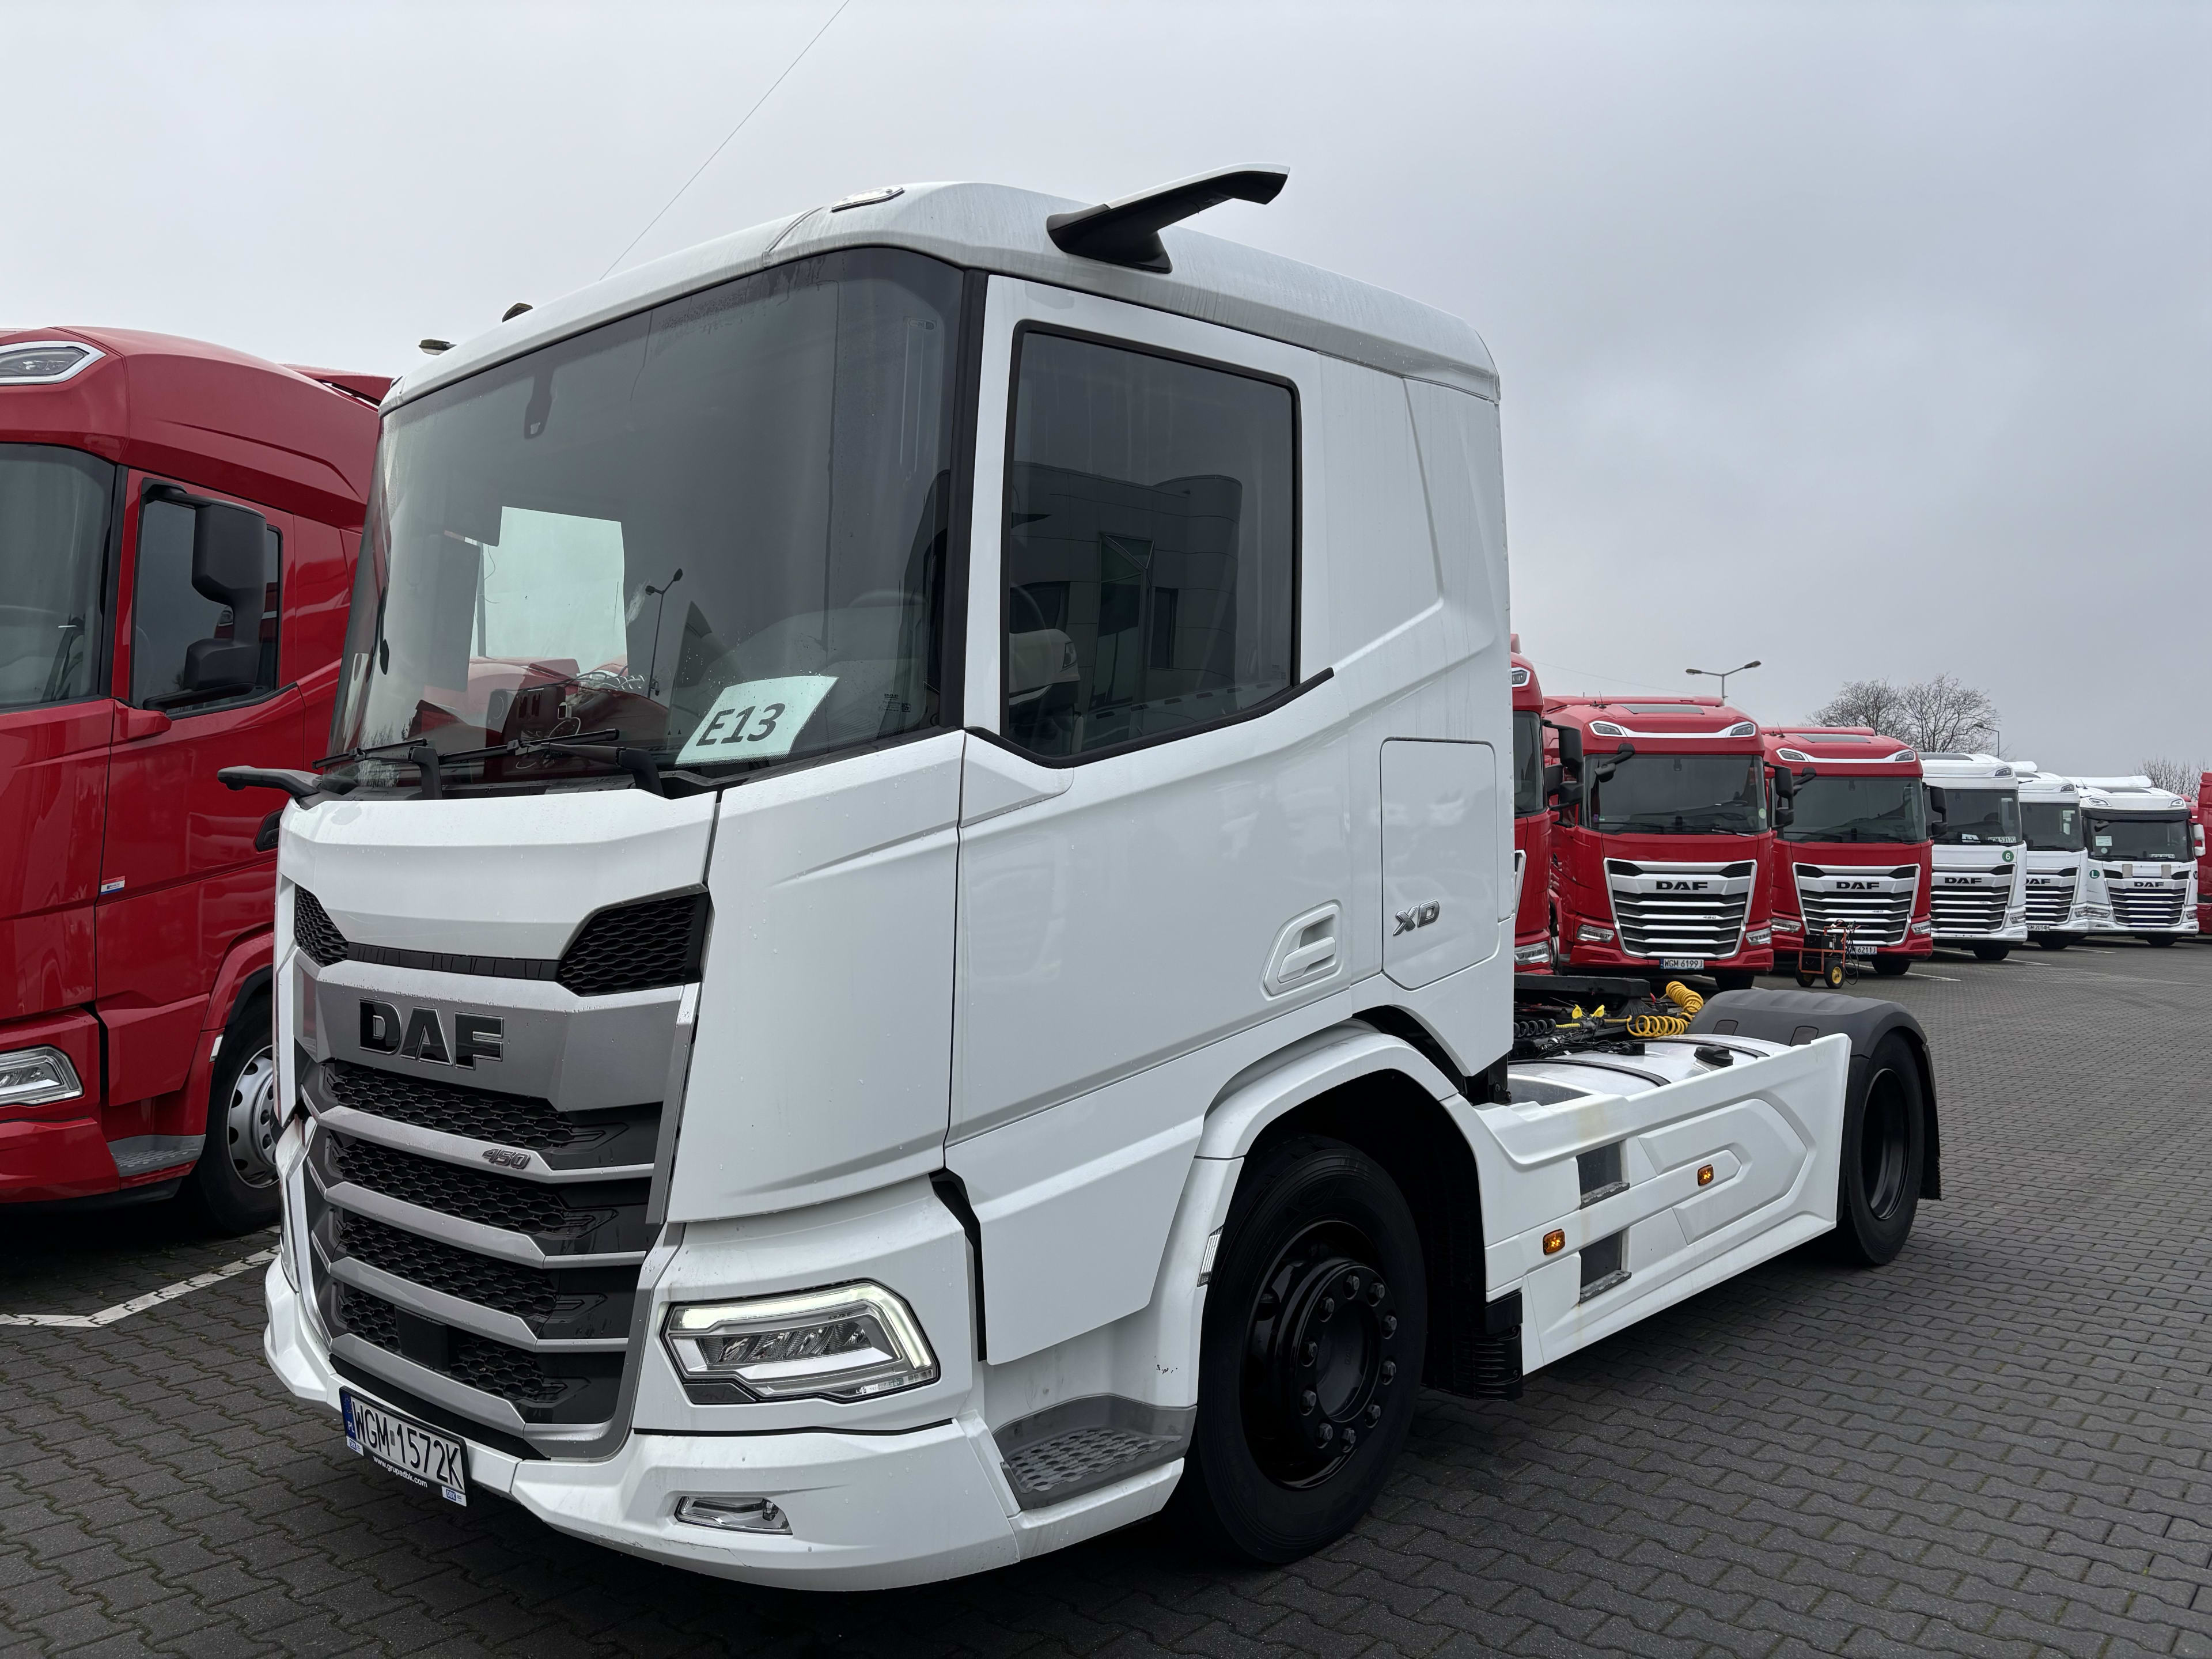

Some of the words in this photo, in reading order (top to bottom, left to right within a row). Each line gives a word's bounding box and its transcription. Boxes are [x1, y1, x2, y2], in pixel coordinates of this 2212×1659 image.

[695, 703, 786, 747] E13
[1656, 881, 1708, 891] DAF
[1836, 881, 1880, 890] DAF
[1392, 899, 1440, 937] XD
[1857, 946, 1876, 954] 6211J
[1664, 959, 1679, 968] WGM
[1680, 959, 1703, 968] 6199J
[359, 997, 505, 1071] DAF
[482, 1148, 531, 1170] 450
[347, 1421, 355, 1433] PL
[352, 1400, 391, 1457] WGM
[396, 1423, 464, 1491] 1572K
[372, 1455, 428, 1488] www.grupadbk.com
